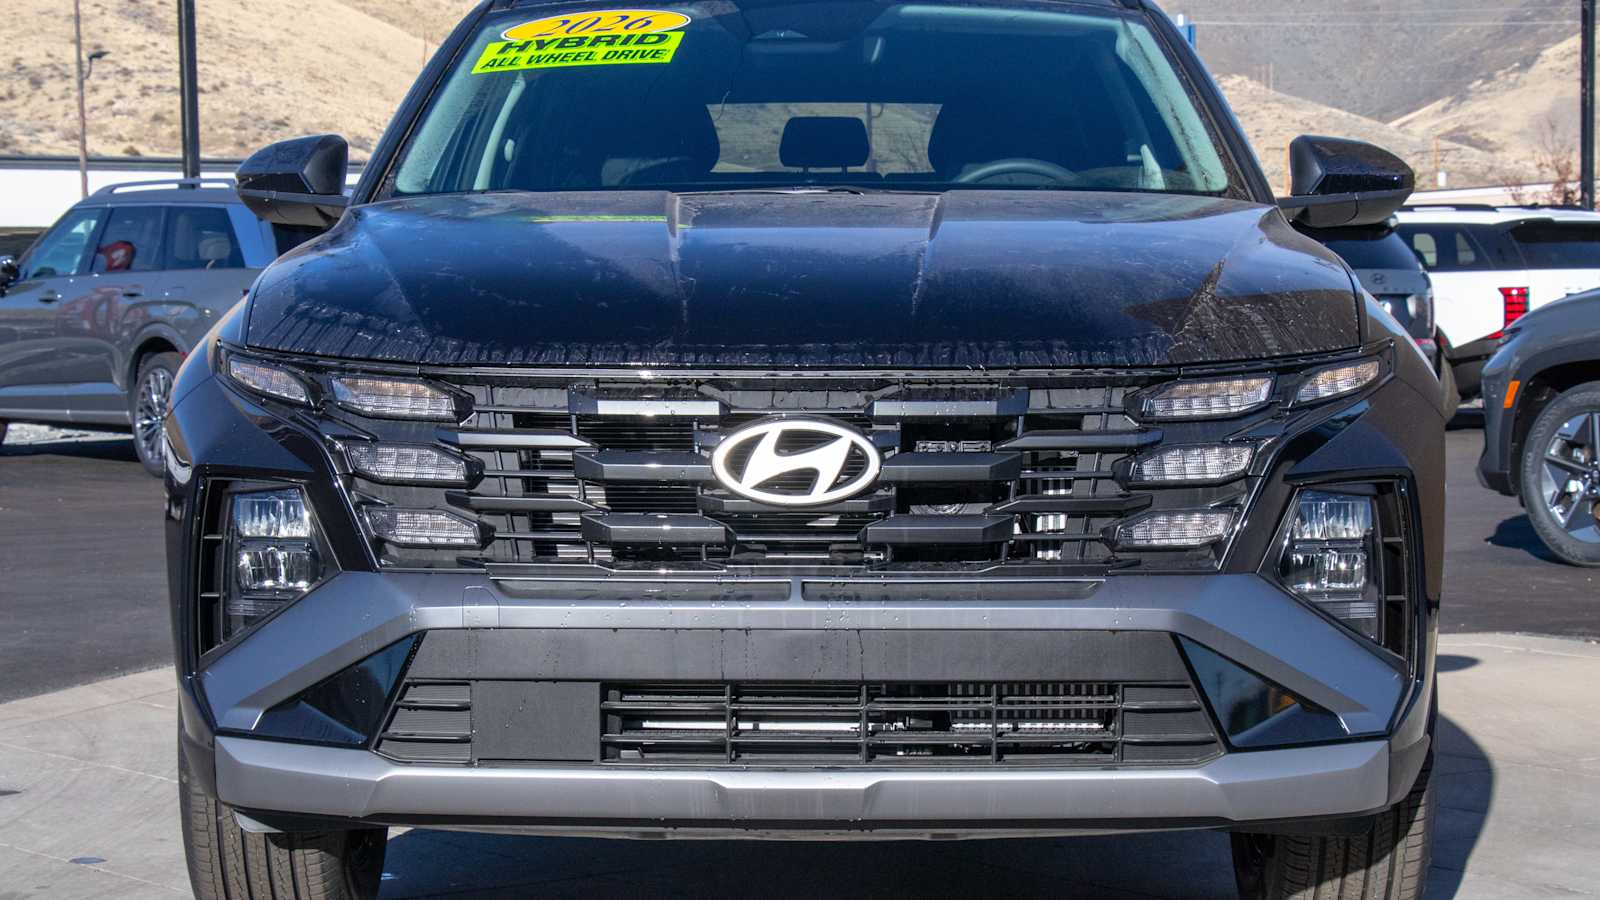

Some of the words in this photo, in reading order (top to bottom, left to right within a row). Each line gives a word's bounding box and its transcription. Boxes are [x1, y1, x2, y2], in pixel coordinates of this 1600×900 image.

[534, 13, 661, 37] 2026
[497, 33, 670, 55] HYBRID
[480, 57, 521, 69] ALL
[526, 52, 597, 65] WHEEL
[601, 49, 666, 61] DRIVE
